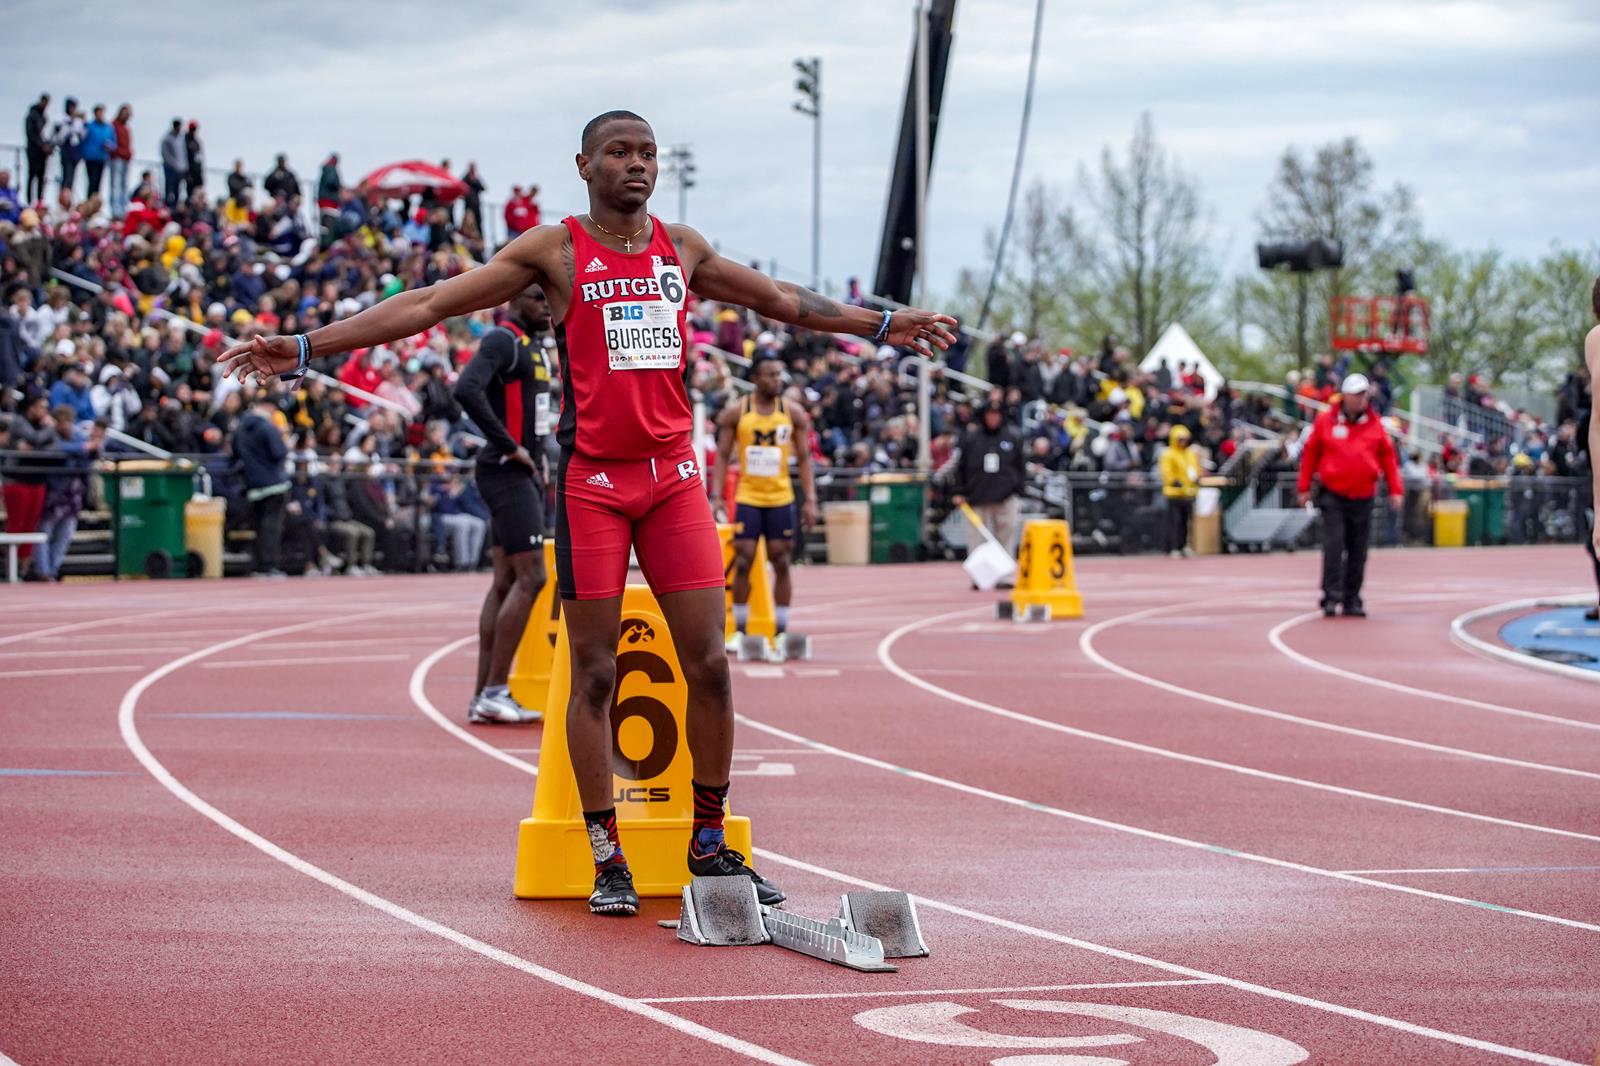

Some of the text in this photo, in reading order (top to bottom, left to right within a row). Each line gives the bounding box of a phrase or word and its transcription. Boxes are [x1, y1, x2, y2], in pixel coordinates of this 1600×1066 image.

[584, 265, 608, 273] adidas
[581, 278, 661, 302] RUTGE
[660, 272, 682, 303] 6
[607, 327, 681, 350] BURGESS
[753, 430, 776, 446] M
[676, 460, 699, 481] R
[586, 478, 614, 489] adidas
[1050, 543, 1065, 579] 3
[610, 650, 678, 780] 6
